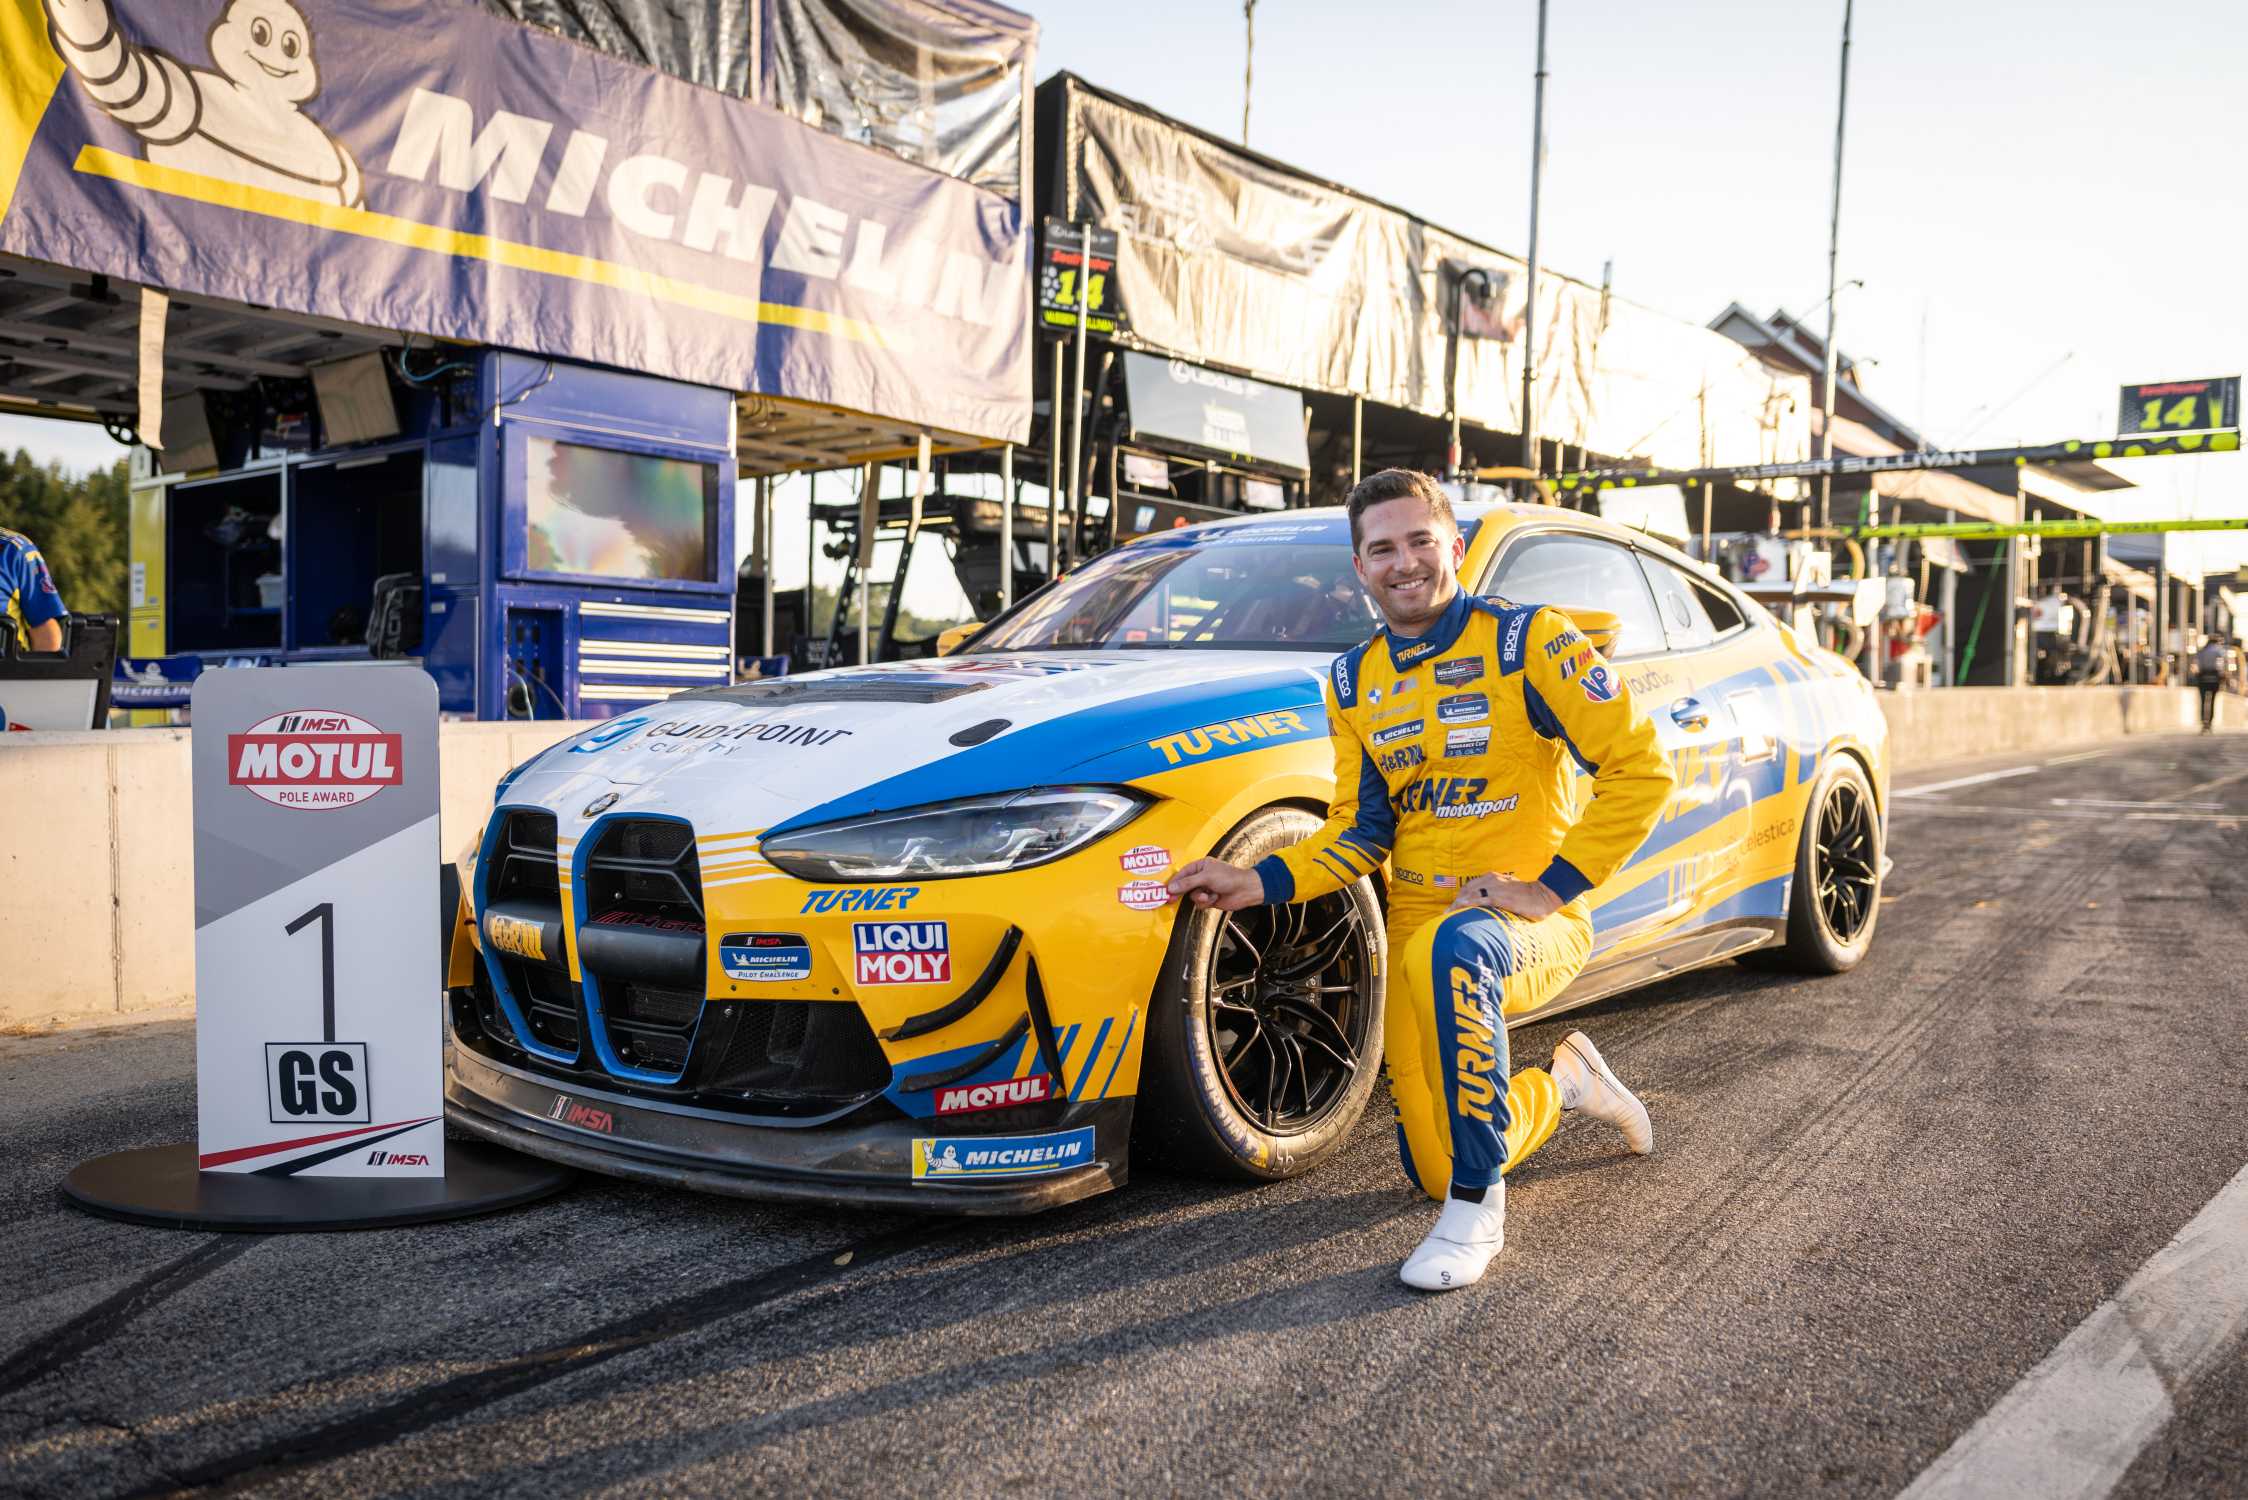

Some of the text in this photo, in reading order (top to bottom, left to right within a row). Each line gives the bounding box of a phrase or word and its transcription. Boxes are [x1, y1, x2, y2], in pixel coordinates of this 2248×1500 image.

[387, 88, 1010, 326] MICHELIN
[2139, 396, 2198, 430] 14
[1842, 451, 1977, 474] SULLIVAN
[1503, 612, 1528, 661] sparco
[111, 686, 192, 698] MICHELIN
[301, 718, 351, 732] IMSA
[646, 720, 853, 748] GUIDEPOINT
[1147, 711, 1311, 765] TURNER
[236, 743, 394, 779] MOTUL
[279, 791, 355, 803] POLE AWARD
[1436, 792, 1520, 819] motorsport
[1123, 852, 1170, 870] MOTUL
[800, 887, 920, 914] TURNER
[1120, 887, 1170, 902] MOTUL
[858, 924, 945, 951] LIQUI
[284, 903, 335, 1043] 1
[861, 953, 948, 982] MOLY
[1450, 966, 1496, 1123] TURNER
[279, 1050, 357, 1116] GS
[941, 1079, 1046, 1111] MOTUL
[566, 1103, 612, 1134] IMSA
[386, 1154, 430, 1166] IMSA
[965, 1141, 1082, 1166] MICHELIN
